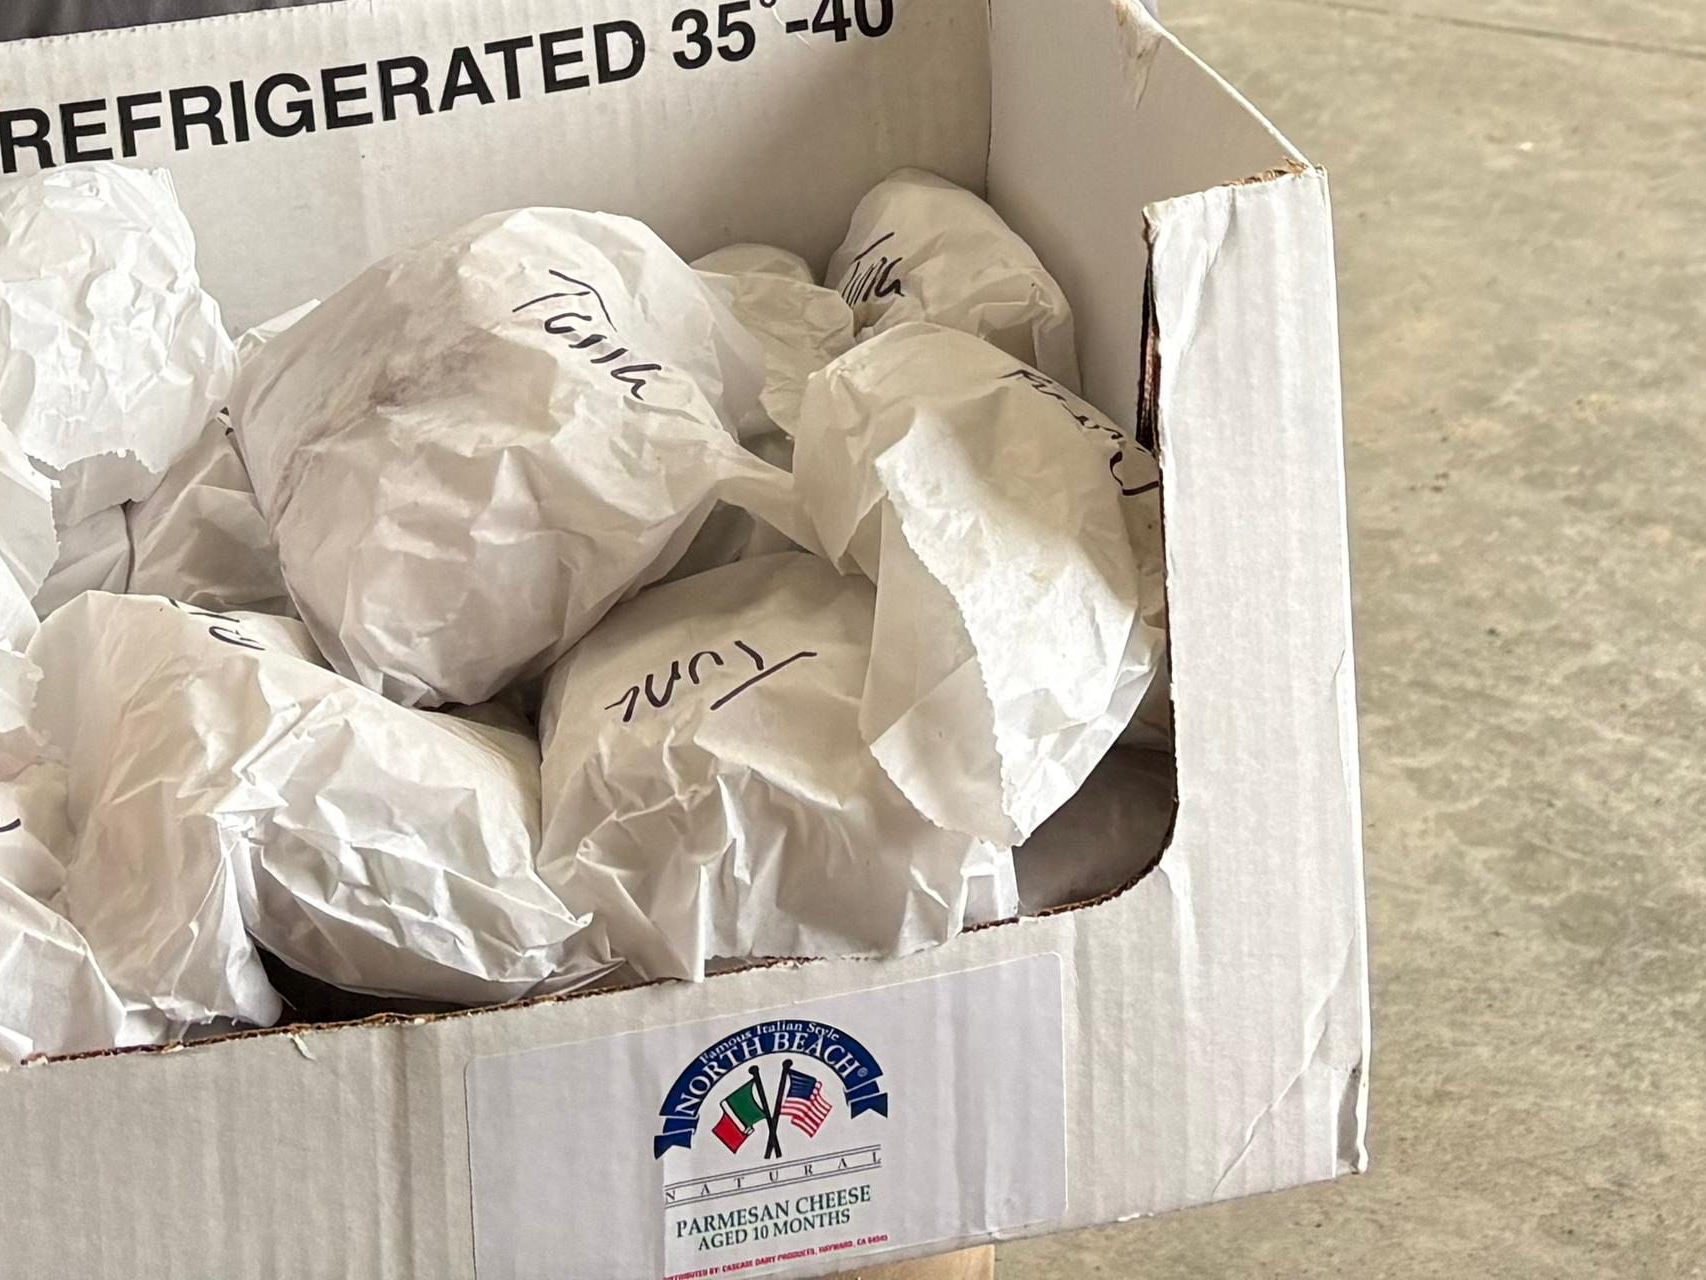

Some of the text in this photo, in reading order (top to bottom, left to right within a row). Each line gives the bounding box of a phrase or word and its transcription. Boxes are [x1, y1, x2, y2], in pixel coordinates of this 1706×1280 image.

[0, 18, 646, 175] REFRIGERATED
[698, 1021, 841, 1065] Famous Italian Style
[675, 1037, 763, 1116] NORTH
[676, 1184, 872, 1238] PARMESAN CHEESE
[698, 1208, 851, 1251] AGED 10 MONTHS
